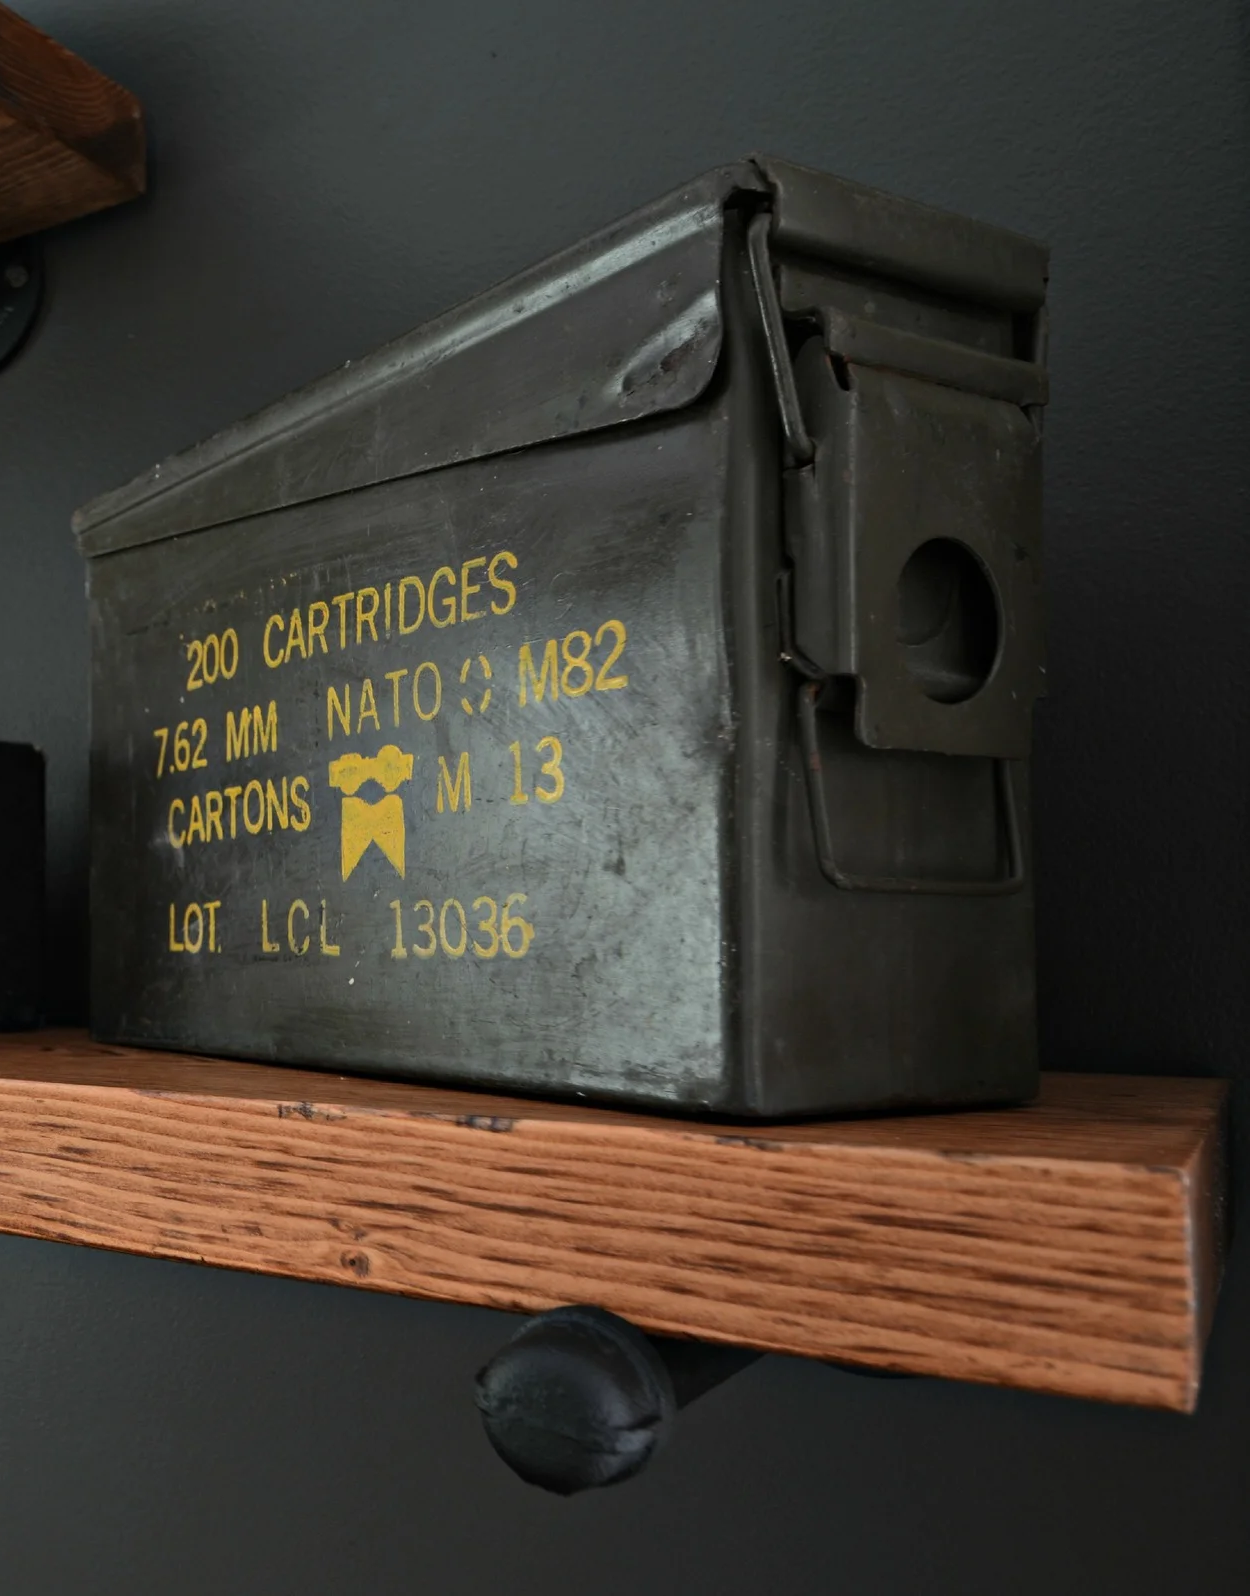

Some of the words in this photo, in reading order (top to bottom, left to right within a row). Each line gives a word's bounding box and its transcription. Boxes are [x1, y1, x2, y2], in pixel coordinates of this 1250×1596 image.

[186, 627, 239, 692] 200
[262, 551, 518, 669] CARTRIDGES
[152, 717, 208, 778] 7.62
[225, 699, 278, 762] MM
[326, 661, 442, 739] NATO
[518, 619, 629, 707] M82
[168, 775, 312, 848] CARTONS
[436, 752, 472, 814] M
[509, 736, 565, 805] 13
[390, 893, 535, 959] 13036
